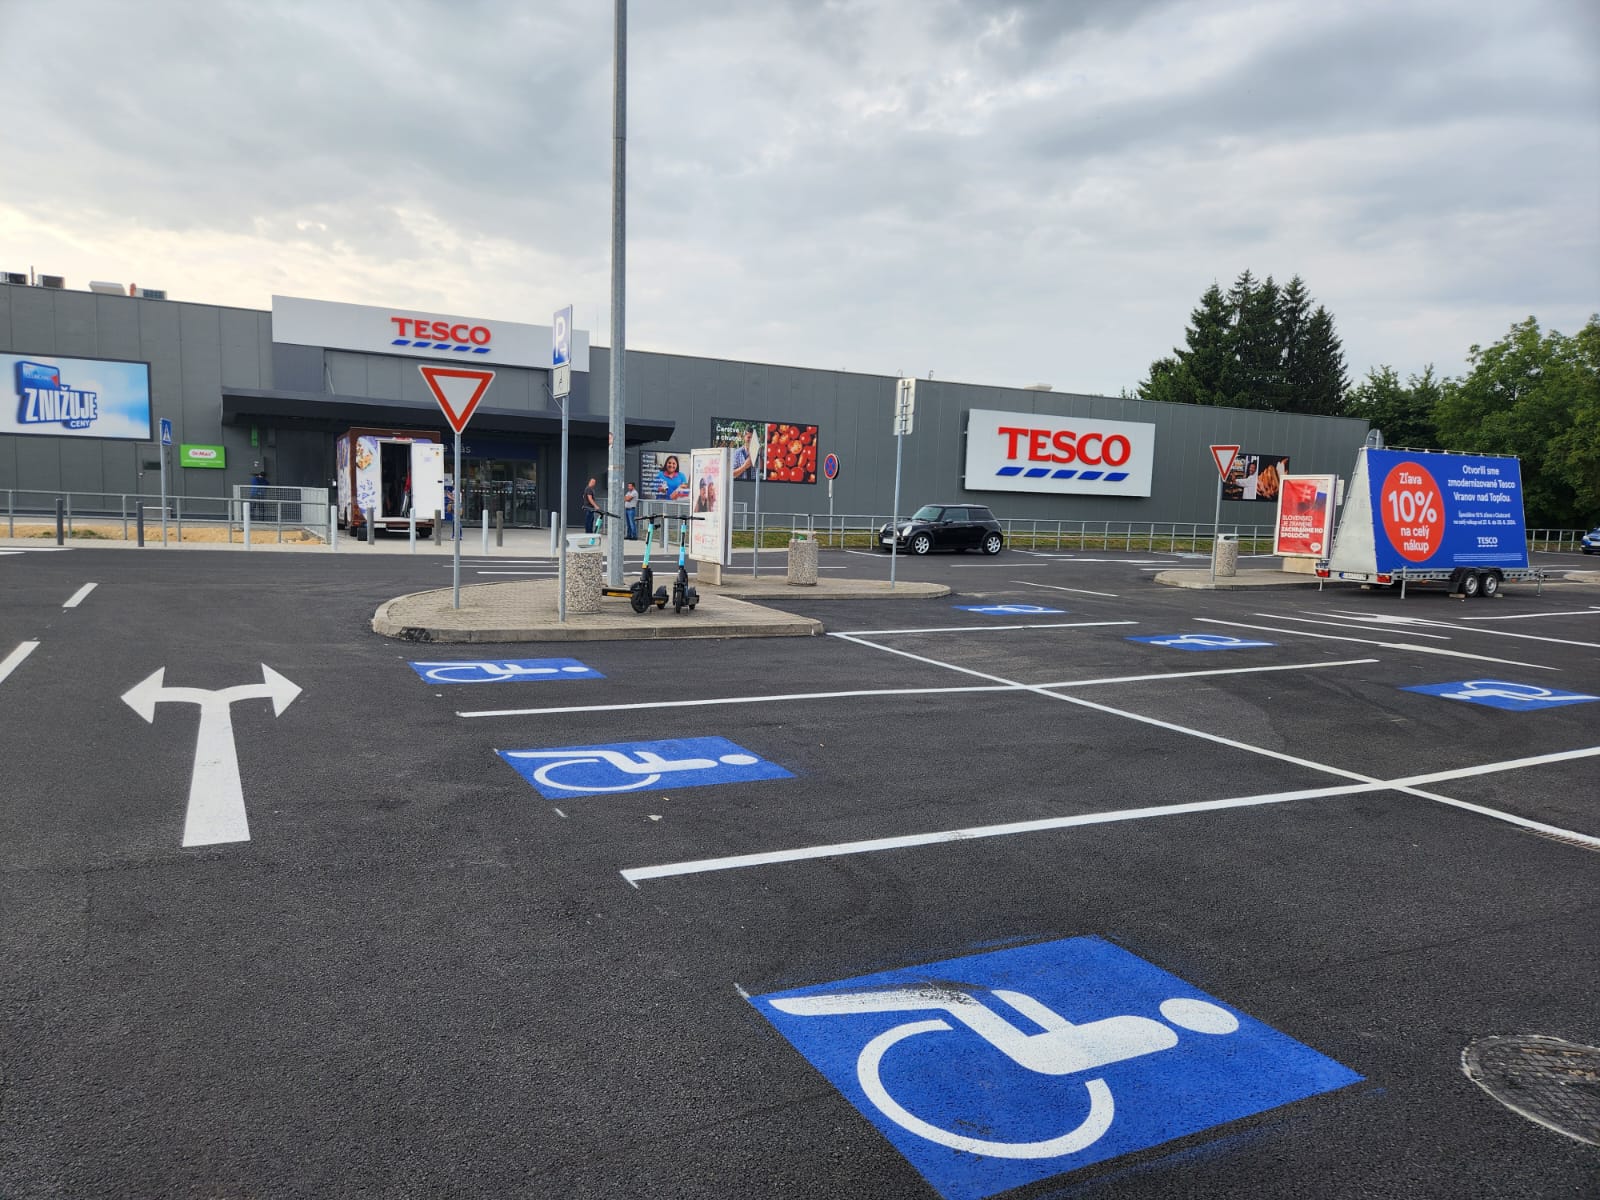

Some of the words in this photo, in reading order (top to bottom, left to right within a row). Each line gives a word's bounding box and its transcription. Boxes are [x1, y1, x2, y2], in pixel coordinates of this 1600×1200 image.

[391, 317, 491, 345] TESCO
[555, 315, 566, 358] P
[24, 385, 97, 421] ZNIŽUJE
[70, 420, 90, 428] CENY
[998, 426, 1131, 466] TESCO
[1399, 472, 1422, 485] Zľava
[1448, 478, 1497, 488] zmodernizované
[1498, 479, 1516, 488] Tesco
[1453, 491, 1476, 501] Vranov
[1477, 492, 1489, 502] nad
[1388, 490, 1437, 523] 10%
[1401, 527, 1411, 536] na
[1413, 525, 1429, 539] celý
[1403, 539, 1429, 554] nákup
[1477, 536, 1498, 544] TESCO
